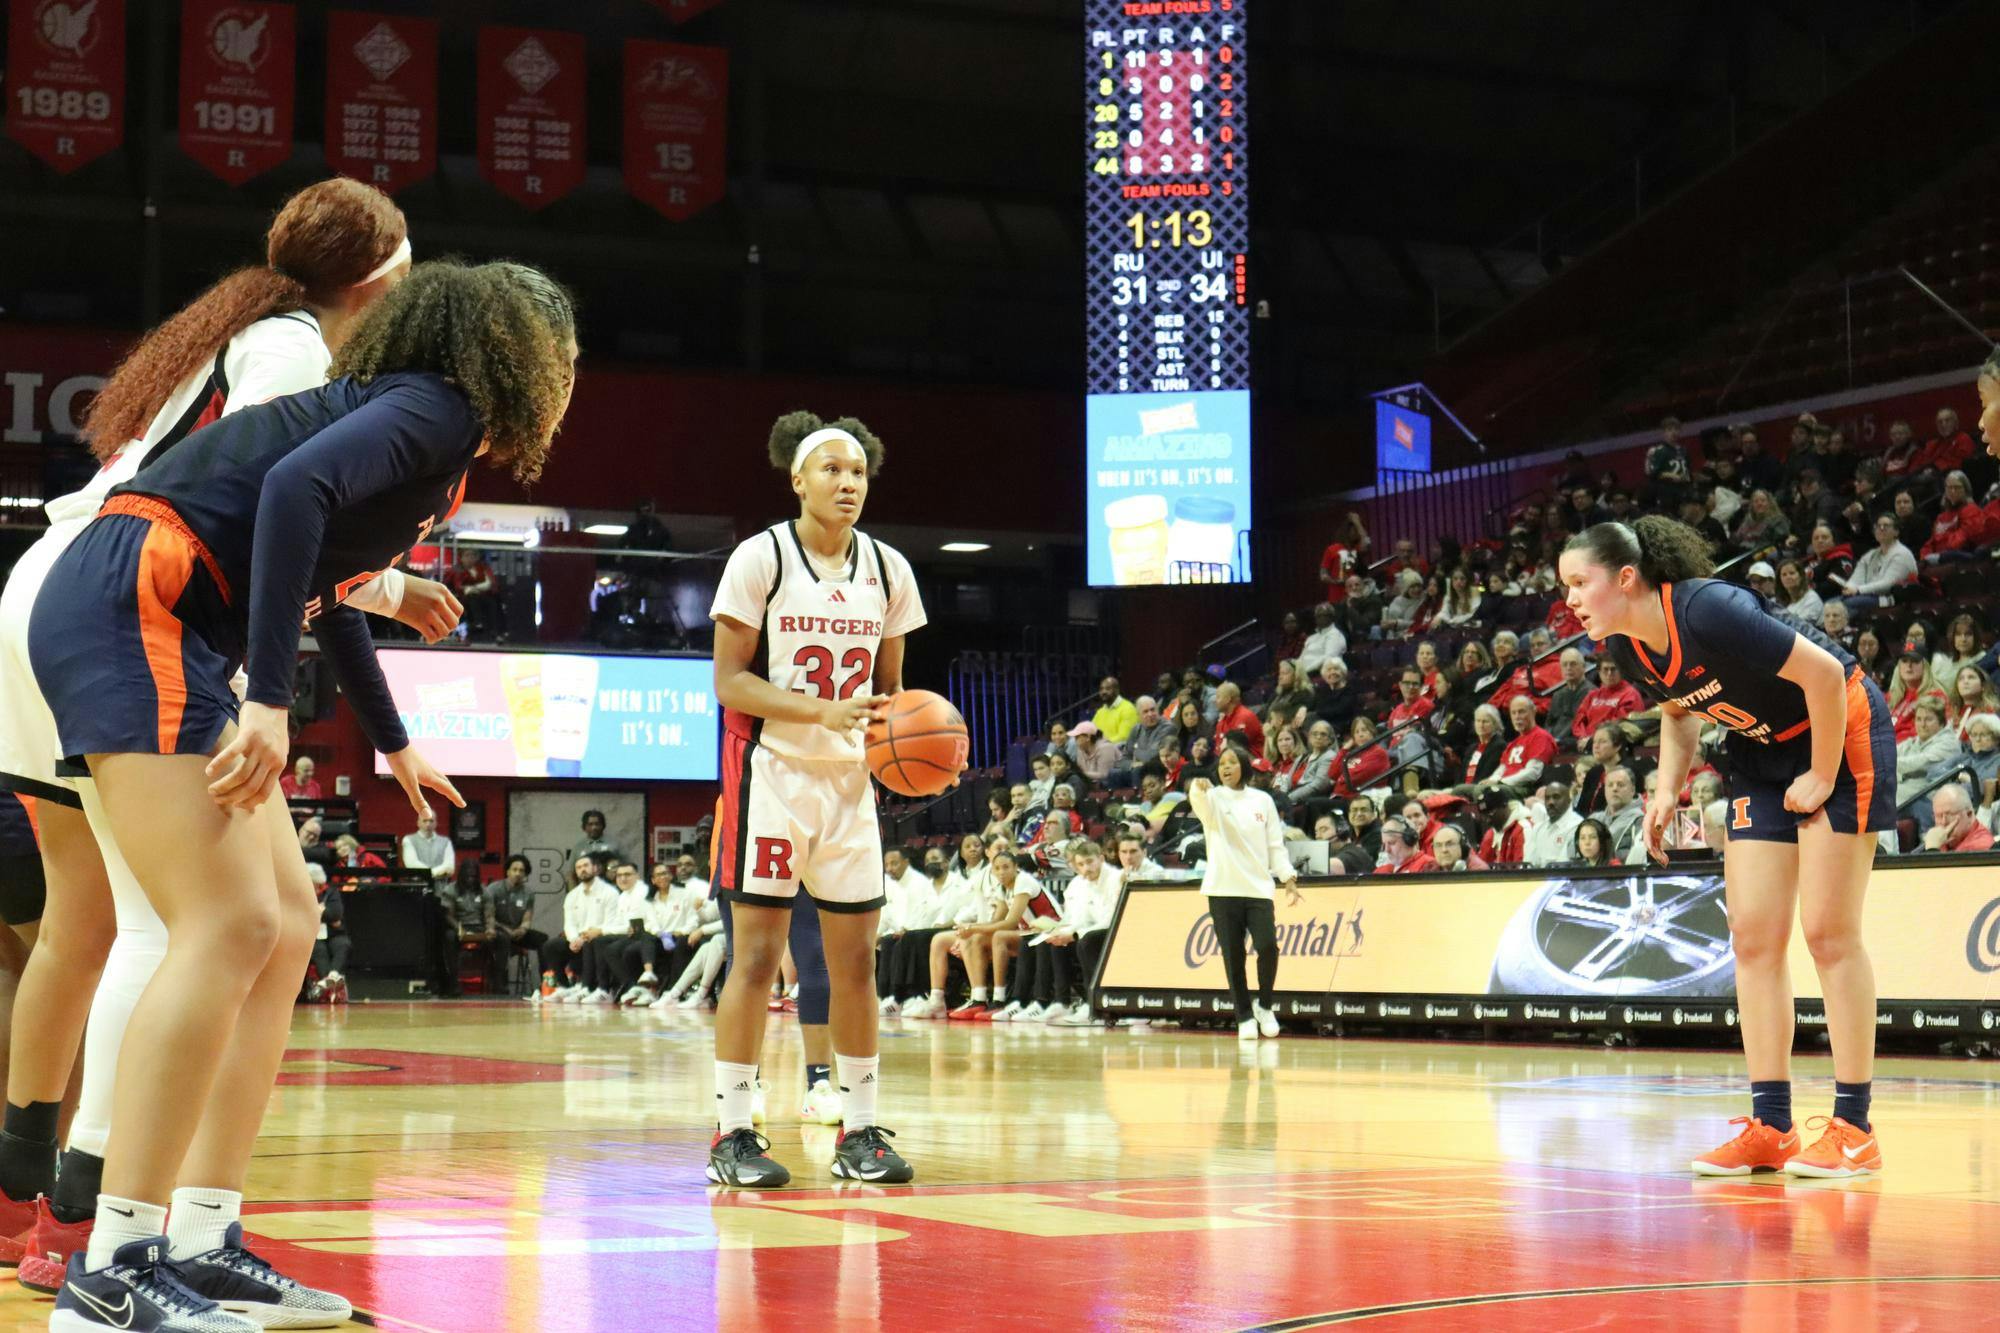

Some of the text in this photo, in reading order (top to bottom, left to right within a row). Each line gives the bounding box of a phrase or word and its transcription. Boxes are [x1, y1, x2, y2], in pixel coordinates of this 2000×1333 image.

[1123, 4, 1162, 15] TEAM
[1164, 2, 1211, 13] FOULS
[1093, 25, 1234, 47] PL PT R A F
[1102, 46, 1232, 69] 1 11 3 1 0
[1100, 73, 1232, 96] 8 3 0 0 2
[17, 86, 110, 121] 1989
[1094, 99, 1232, 122] 20 5 2 1 2
[194, 101, 275, 134] 1991
[56, 137, 75, 155] R
[1094, 126, 1232, 149] 23 0 4 1 0
[227, 150, 246, 167] R
[655, 143, 694, 171] 15
[1094, 157, 1119, 175] 44
[1160, 155, 1173, 172] 3
[1191, 153, 1204, 171] 2
[1222, 152, 1232, 170] 1
[373, 164, 390, 181] R
[525, 176, 543, 194] R
[1122, 182, 1232, 198] TEAM FOULS 3
[668, 187, 688, 205] R
[1127, 210, 1212, 248] 1:13
[1114, 251, 1223, 271] RU UI
[1112, 276, 1147, 305] 31
[1190, 273, 1228, 302] 34
[1118, 311, 1224, 327] 9 REB 15
[1118, 330, 1128, 342] 4
[1155, 331, 1184, 343] BLK
[1119, 346, 1128, 358] 5
[1157, 347, 1184, 359] STL
[1156, 363, 1185, 375] AST
[1151, 378, 1189, 391] TURN
[779, 616, 880, 637] RUTGERS
[792, 645, 872, 701] 32
[599, 689, 642, 712] WHEN
[647, 688, 679, 713] IT'S
[684, 691, 714, 717] ON,
[1676, 678, 1723, 708] HTING
[399, 711, 511, 740] MAZING
[622, 721, 689, 746] IT'S ON.
[1508, 746, 1525, 765] R
[1733, 798, 1752, 829] I
[752, 836, 793, 880] R
[1184, 911, 1343, 969] Coental
[1344, 1004, 1365, 1014] Prudential
[1387, 1006, 1410, 1016] Prudential
[1434, 1007, 1458, 1017] Prudential
[1484, 1008, 1508, 1018] Prudential
[1533, 1007, 1559, 1018] Prudential
[1580, 1009, 1606, 1020] Prudential
[1635, 1011, 1661, 1022] Prudential
[1684, 1012, 1712, 1023] Prudential
[1926, 1015, 1959, 1027] Prudential
